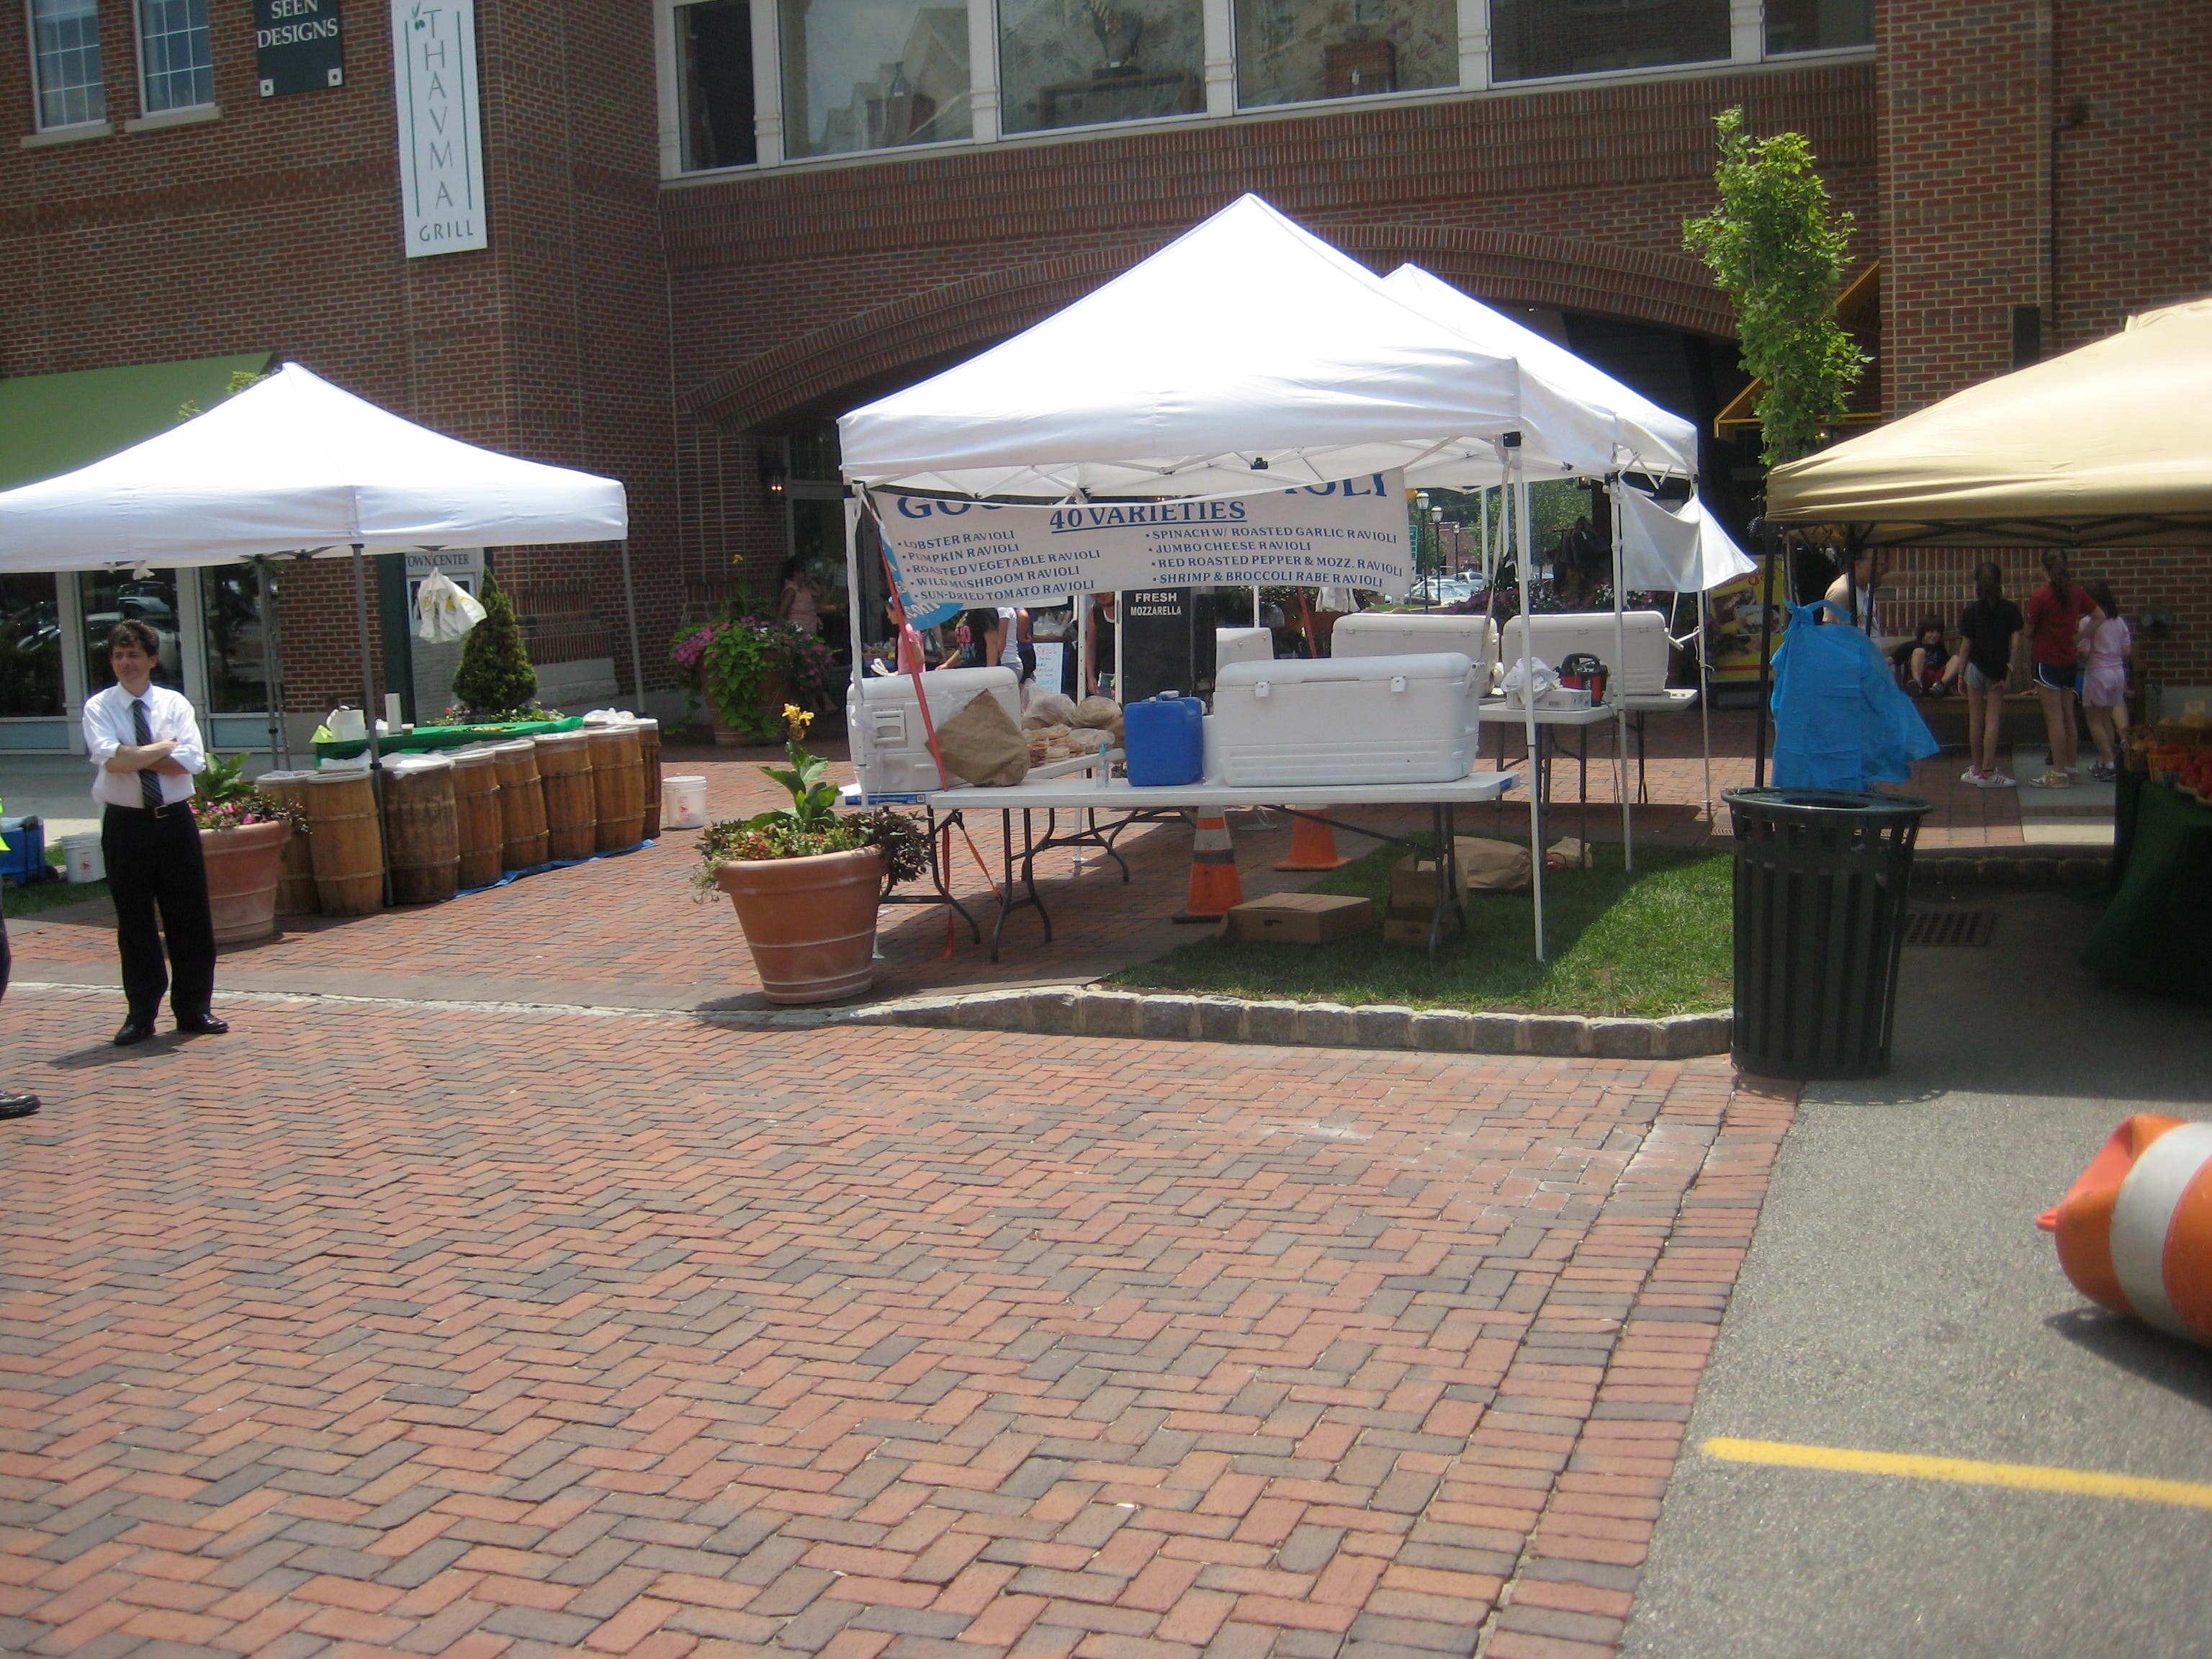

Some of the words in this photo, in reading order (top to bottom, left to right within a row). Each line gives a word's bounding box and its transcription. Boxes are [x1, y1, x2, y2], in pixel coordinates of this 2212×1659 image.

[270, 0, 318, 19] SEEN
[256, 17, 338, 49] DESIGNS
[423, 9, 454, 210] THAVMA
[419, 220, 474, 242] GRILL
[1050, 508, 1082, 529] 40
[1087, 500, 1246, 526] VARIETIES
[904, 534, 961, 550] LOBSTER
[963, 530, 1015, 543] RAVIOLI
[1152, 529, 1210, 539] SPINACH
[1232, 527, 1293, 537] ROASTED
[1296, 527, 1344, 538] GARLIC
[1347, 529, 1397, 544] RAVIOLI
[908, 549, 963, 563] PUMPKIN
[966, 544, 1020, 558] RAVIOLI
[1156, 542, 1202, 554] JUMBO
[1204, 541, 1256, 552] CHEESE
[1259, 541, 1311, 551] RAVIOLI
[433, 554, 470, 566] CENTER
[912, 565, 967, 577] ROASTED
[968, 554, 1046, 573] VEGETABLE
[1048, 549, 1100, 562] RAVIOLI
[1159, 558, 1185, 568] RED
[1189, 555, 1249, 567] ROASTED
[1252, 555, 1302, 565] PEPPER
[1304, 556, 1313, 566] &
[1317, 557, 1355, 569] MOZZ.
[1357, 559, 1403, 577] RAVIOLI
[916, 577, 948, 587] WILD
[949, 572, 1024, 589] MUSHROOM
[1028, 565, 1080, 580] RAVIOLI
[1159, 572, 1210, 584] SHRIMP
[1214, 572, 1223, 582] &
[1226, 570, 1292, 581] BROCCOLI
[1296, 571, 1330, 583] RABE
[1333, 573, 1383, 588] RAVIOLI
[920, 590, 984, 601] SUN-DRIED
[986, 585, 1040, 601] TOMATO
[1043, 580, 1094, 595] RAVIOLI
[1135, 592, 1178, 603] FRESH
[1130, 605, 1182, 616] MOZZARELLA
